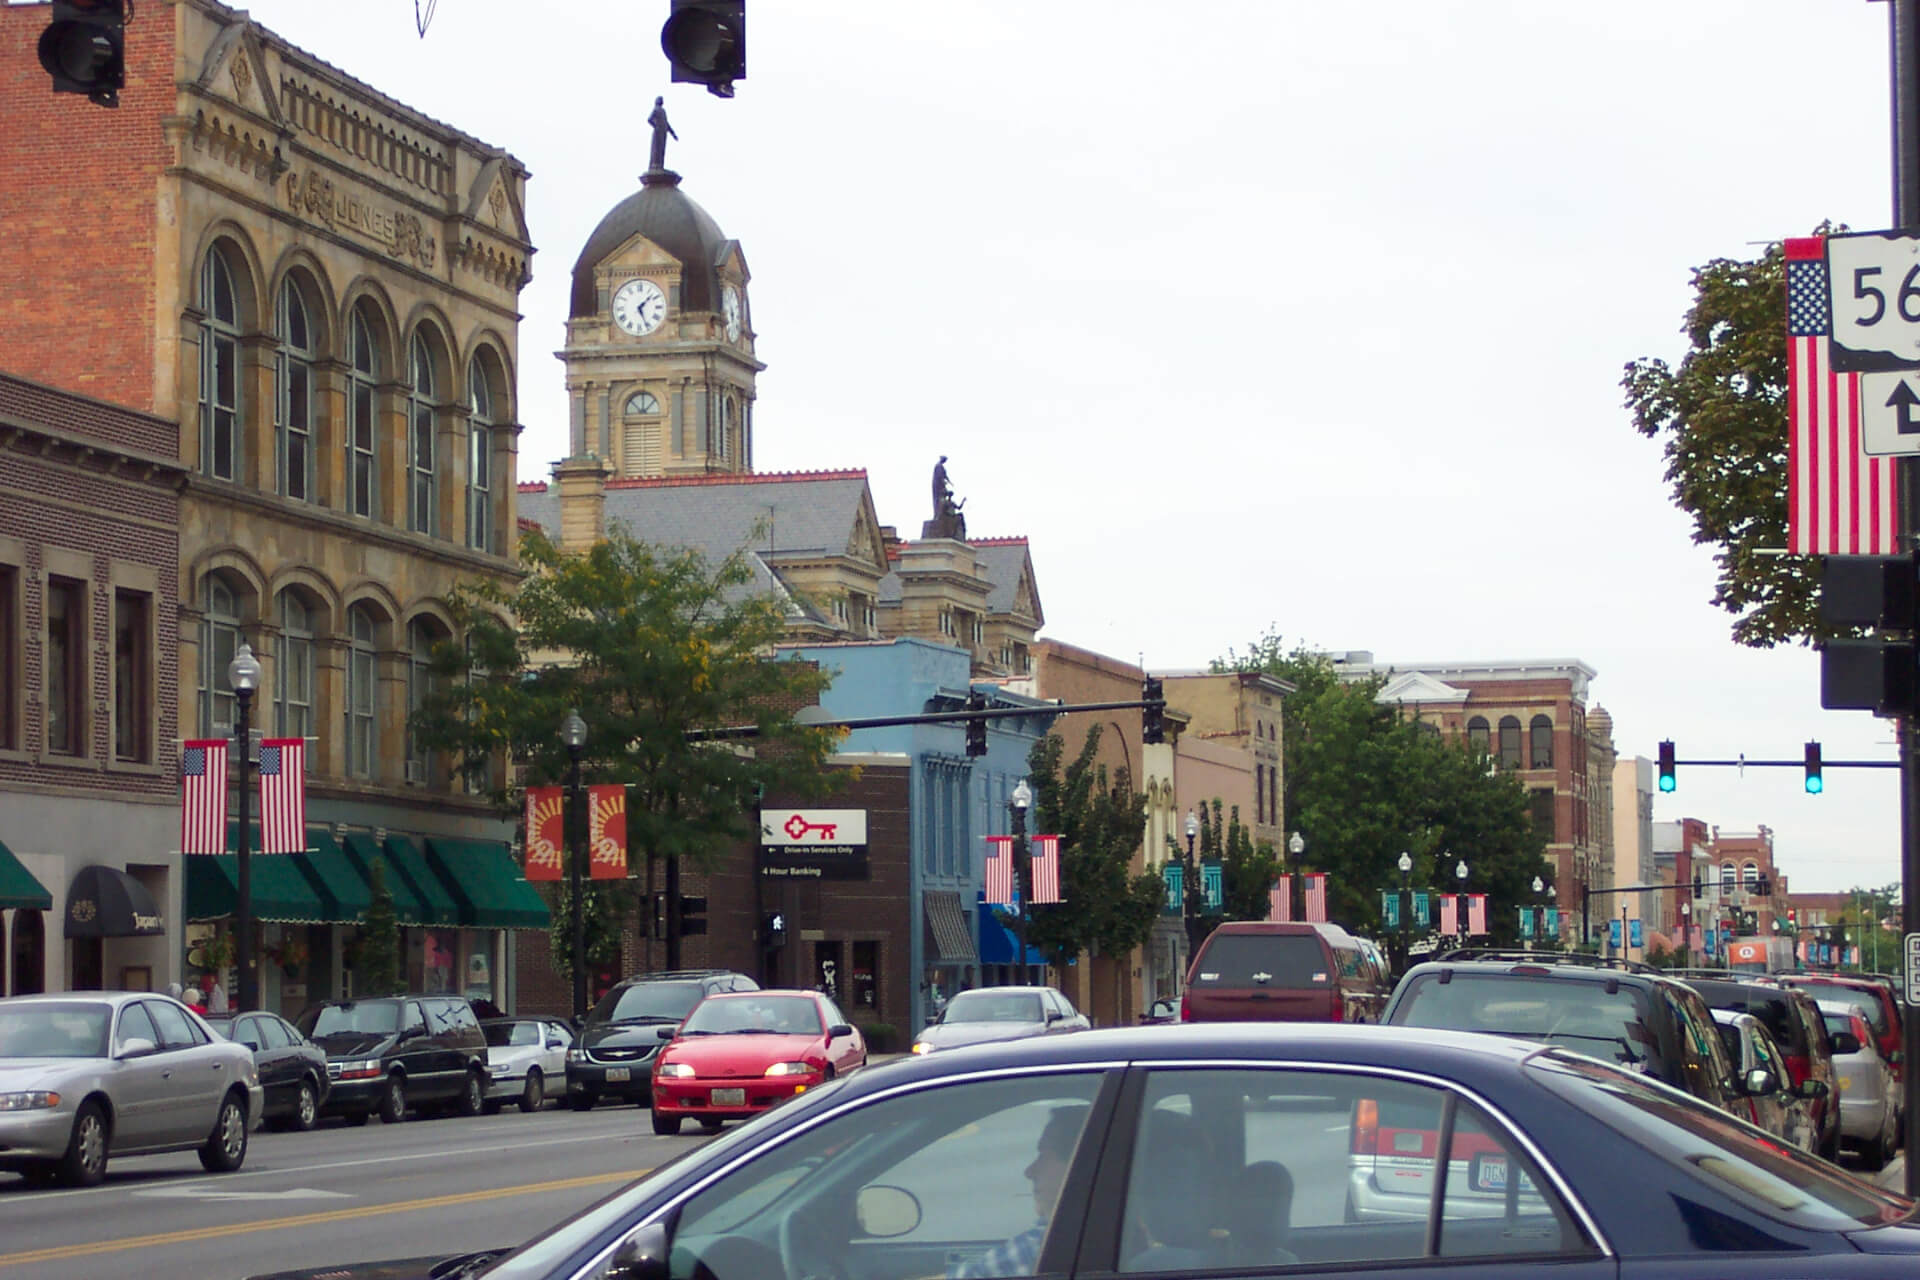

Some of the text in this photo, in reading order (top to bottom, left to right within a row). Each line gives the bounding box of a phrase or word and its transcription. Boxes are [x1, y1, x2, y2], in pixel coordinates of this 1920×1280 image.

[336, 195, 393, 241] JONES
[1854, 263, 1920, 326] 56
[838, 845, 854, 856] Only
[769, 867, 789, 876] Hour
[790, 866, 821, 878] Banking
